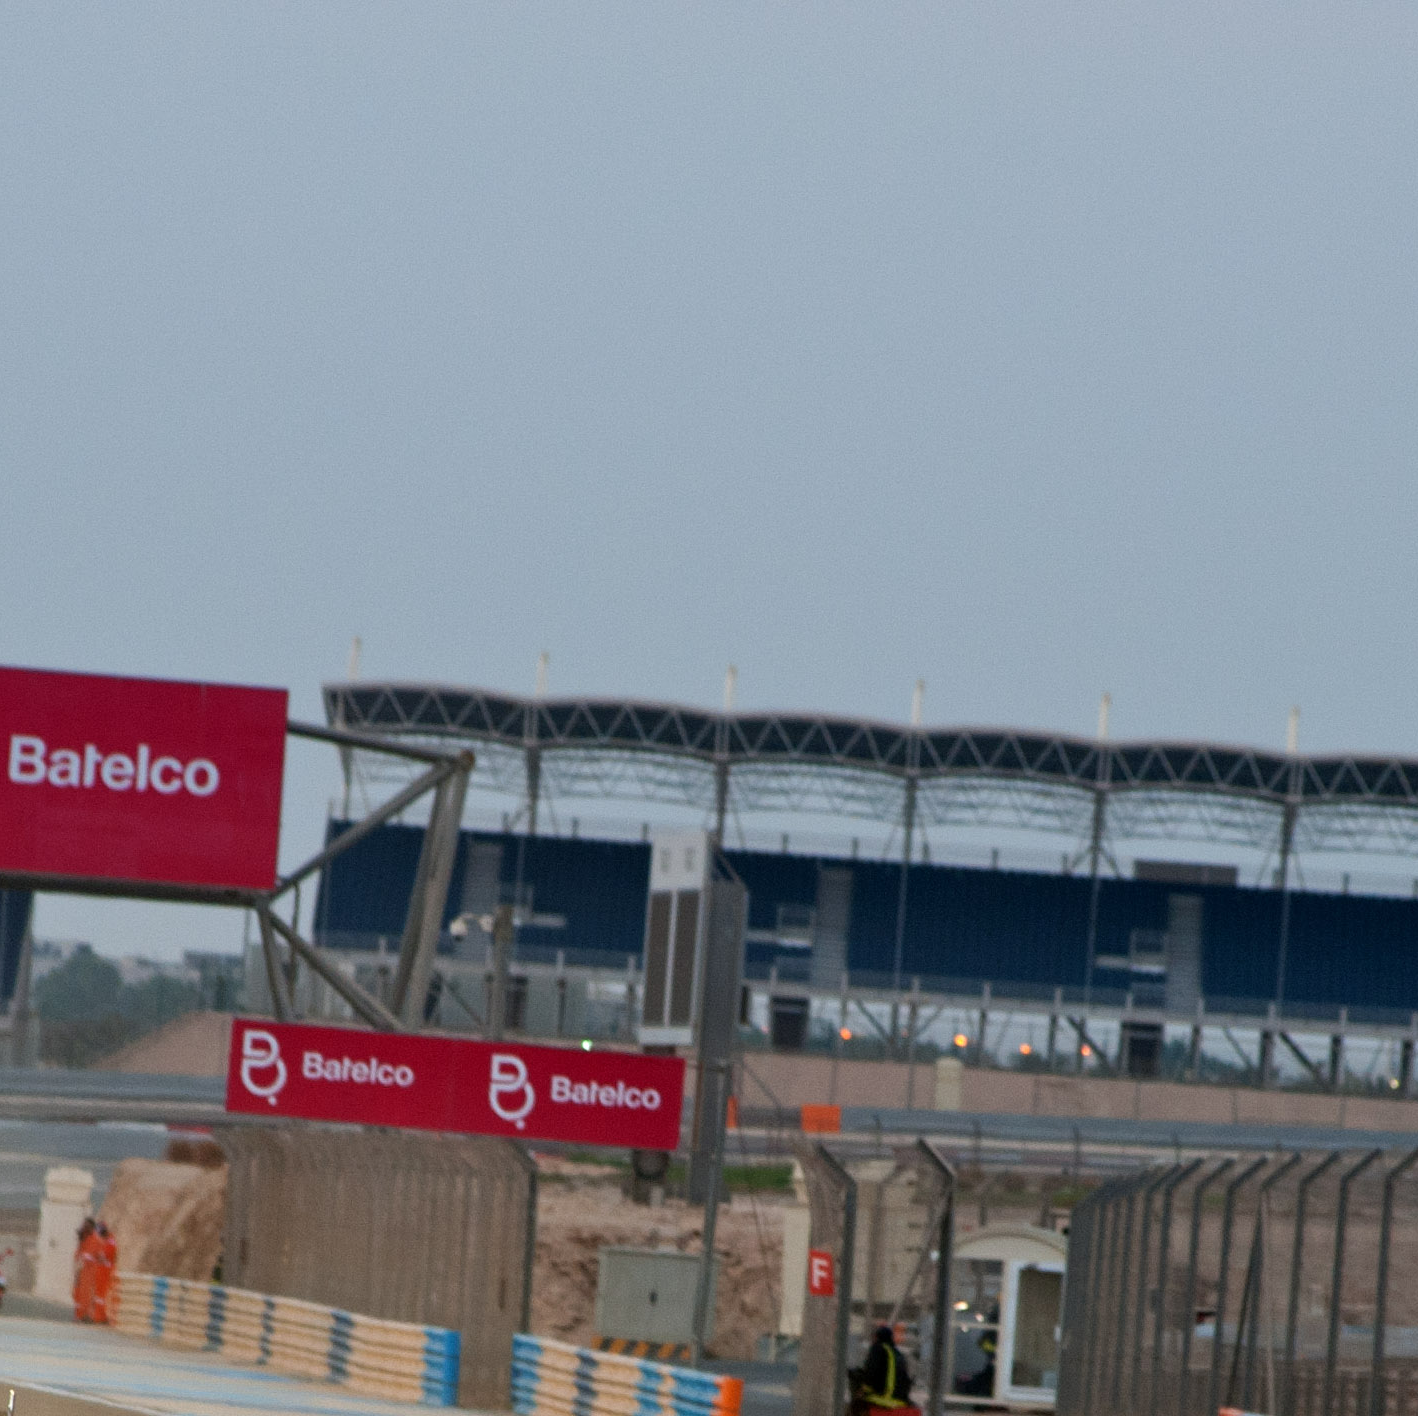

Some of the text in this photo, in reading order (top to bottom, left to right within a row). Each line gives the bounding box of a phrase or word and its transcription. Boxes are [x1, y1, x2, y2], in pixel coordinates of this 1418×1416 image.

[8, 734, 220, 796] Batelco
[302, 1051, 415, 1087] Batelco
[550, 1075, 661, 1110] Batelco
